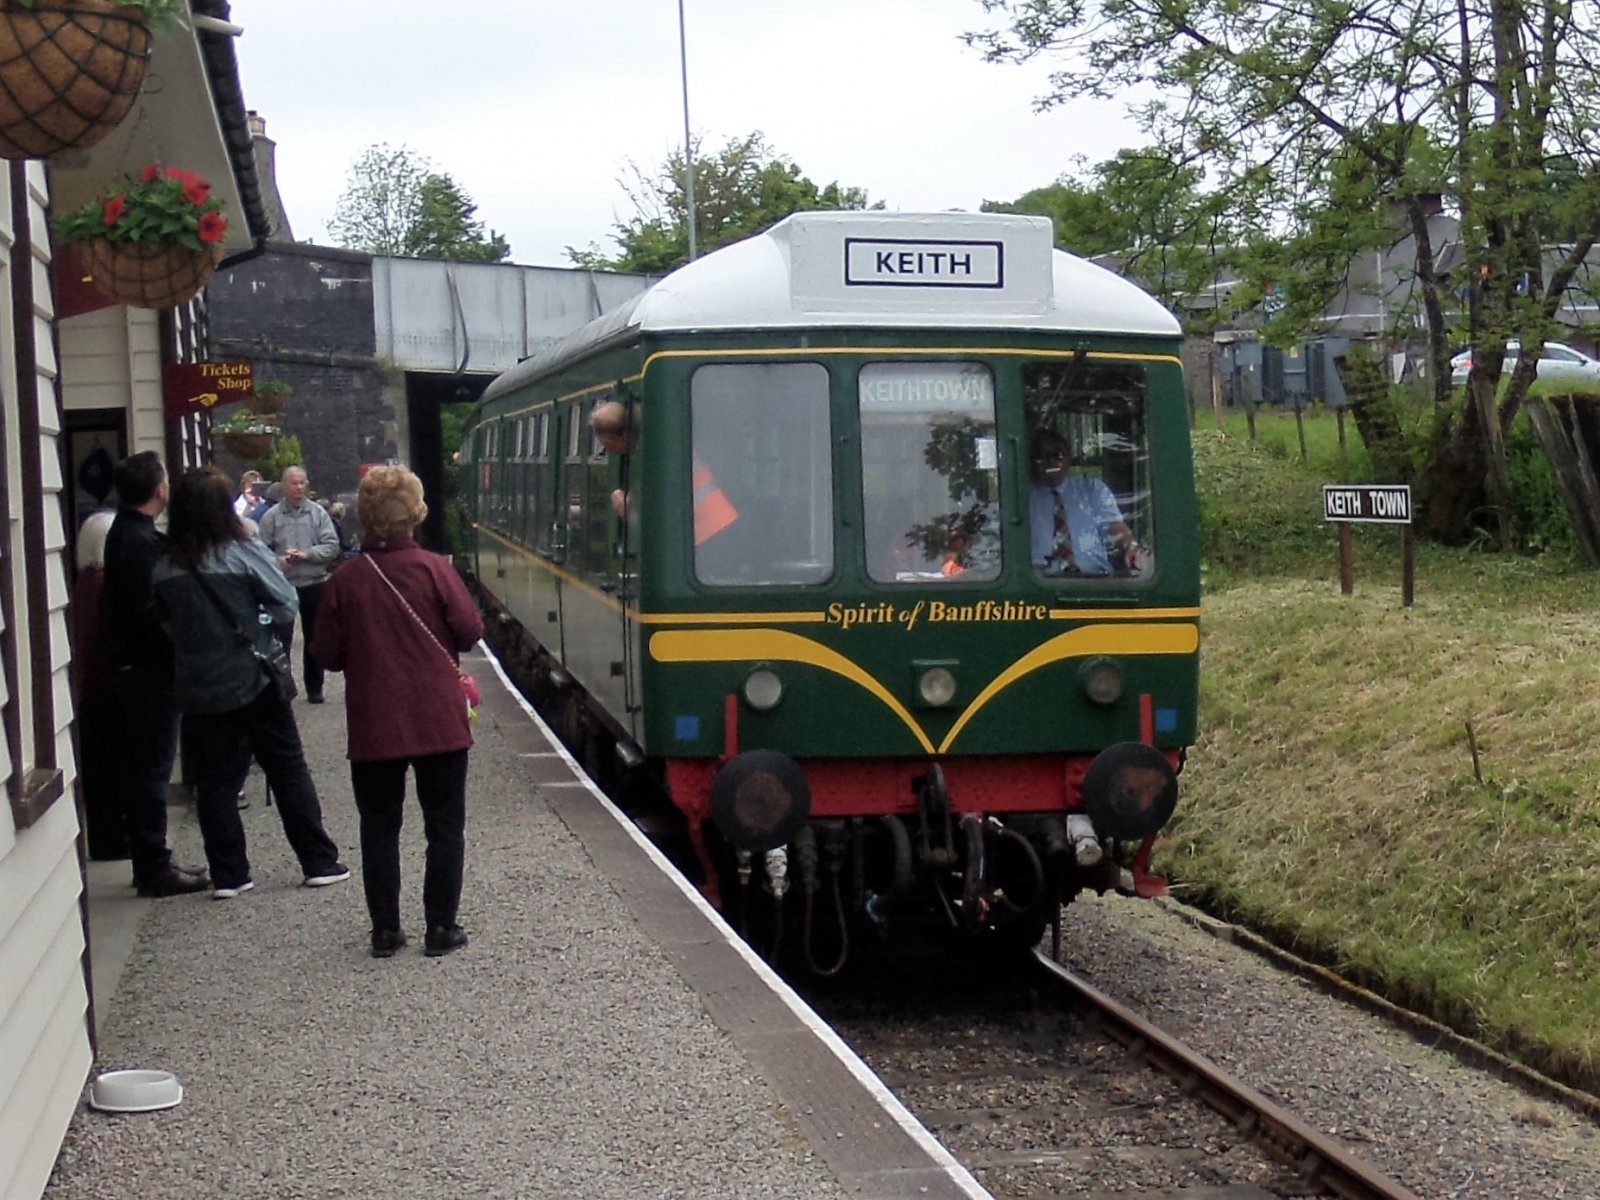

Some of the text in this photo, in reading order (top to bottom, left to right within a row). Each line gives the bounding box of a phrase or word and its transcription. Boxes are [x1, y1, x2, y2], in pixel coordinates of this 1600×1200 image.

[876, 251, 972, 275] KEITH
[200, 363, 251, 377] Tickets
[217, 377, 251, 391] Shop
[1327, 491, 1407, 517] KEITH TOWN
[827, 600, 1048, 631] Spirit of Banffshire
